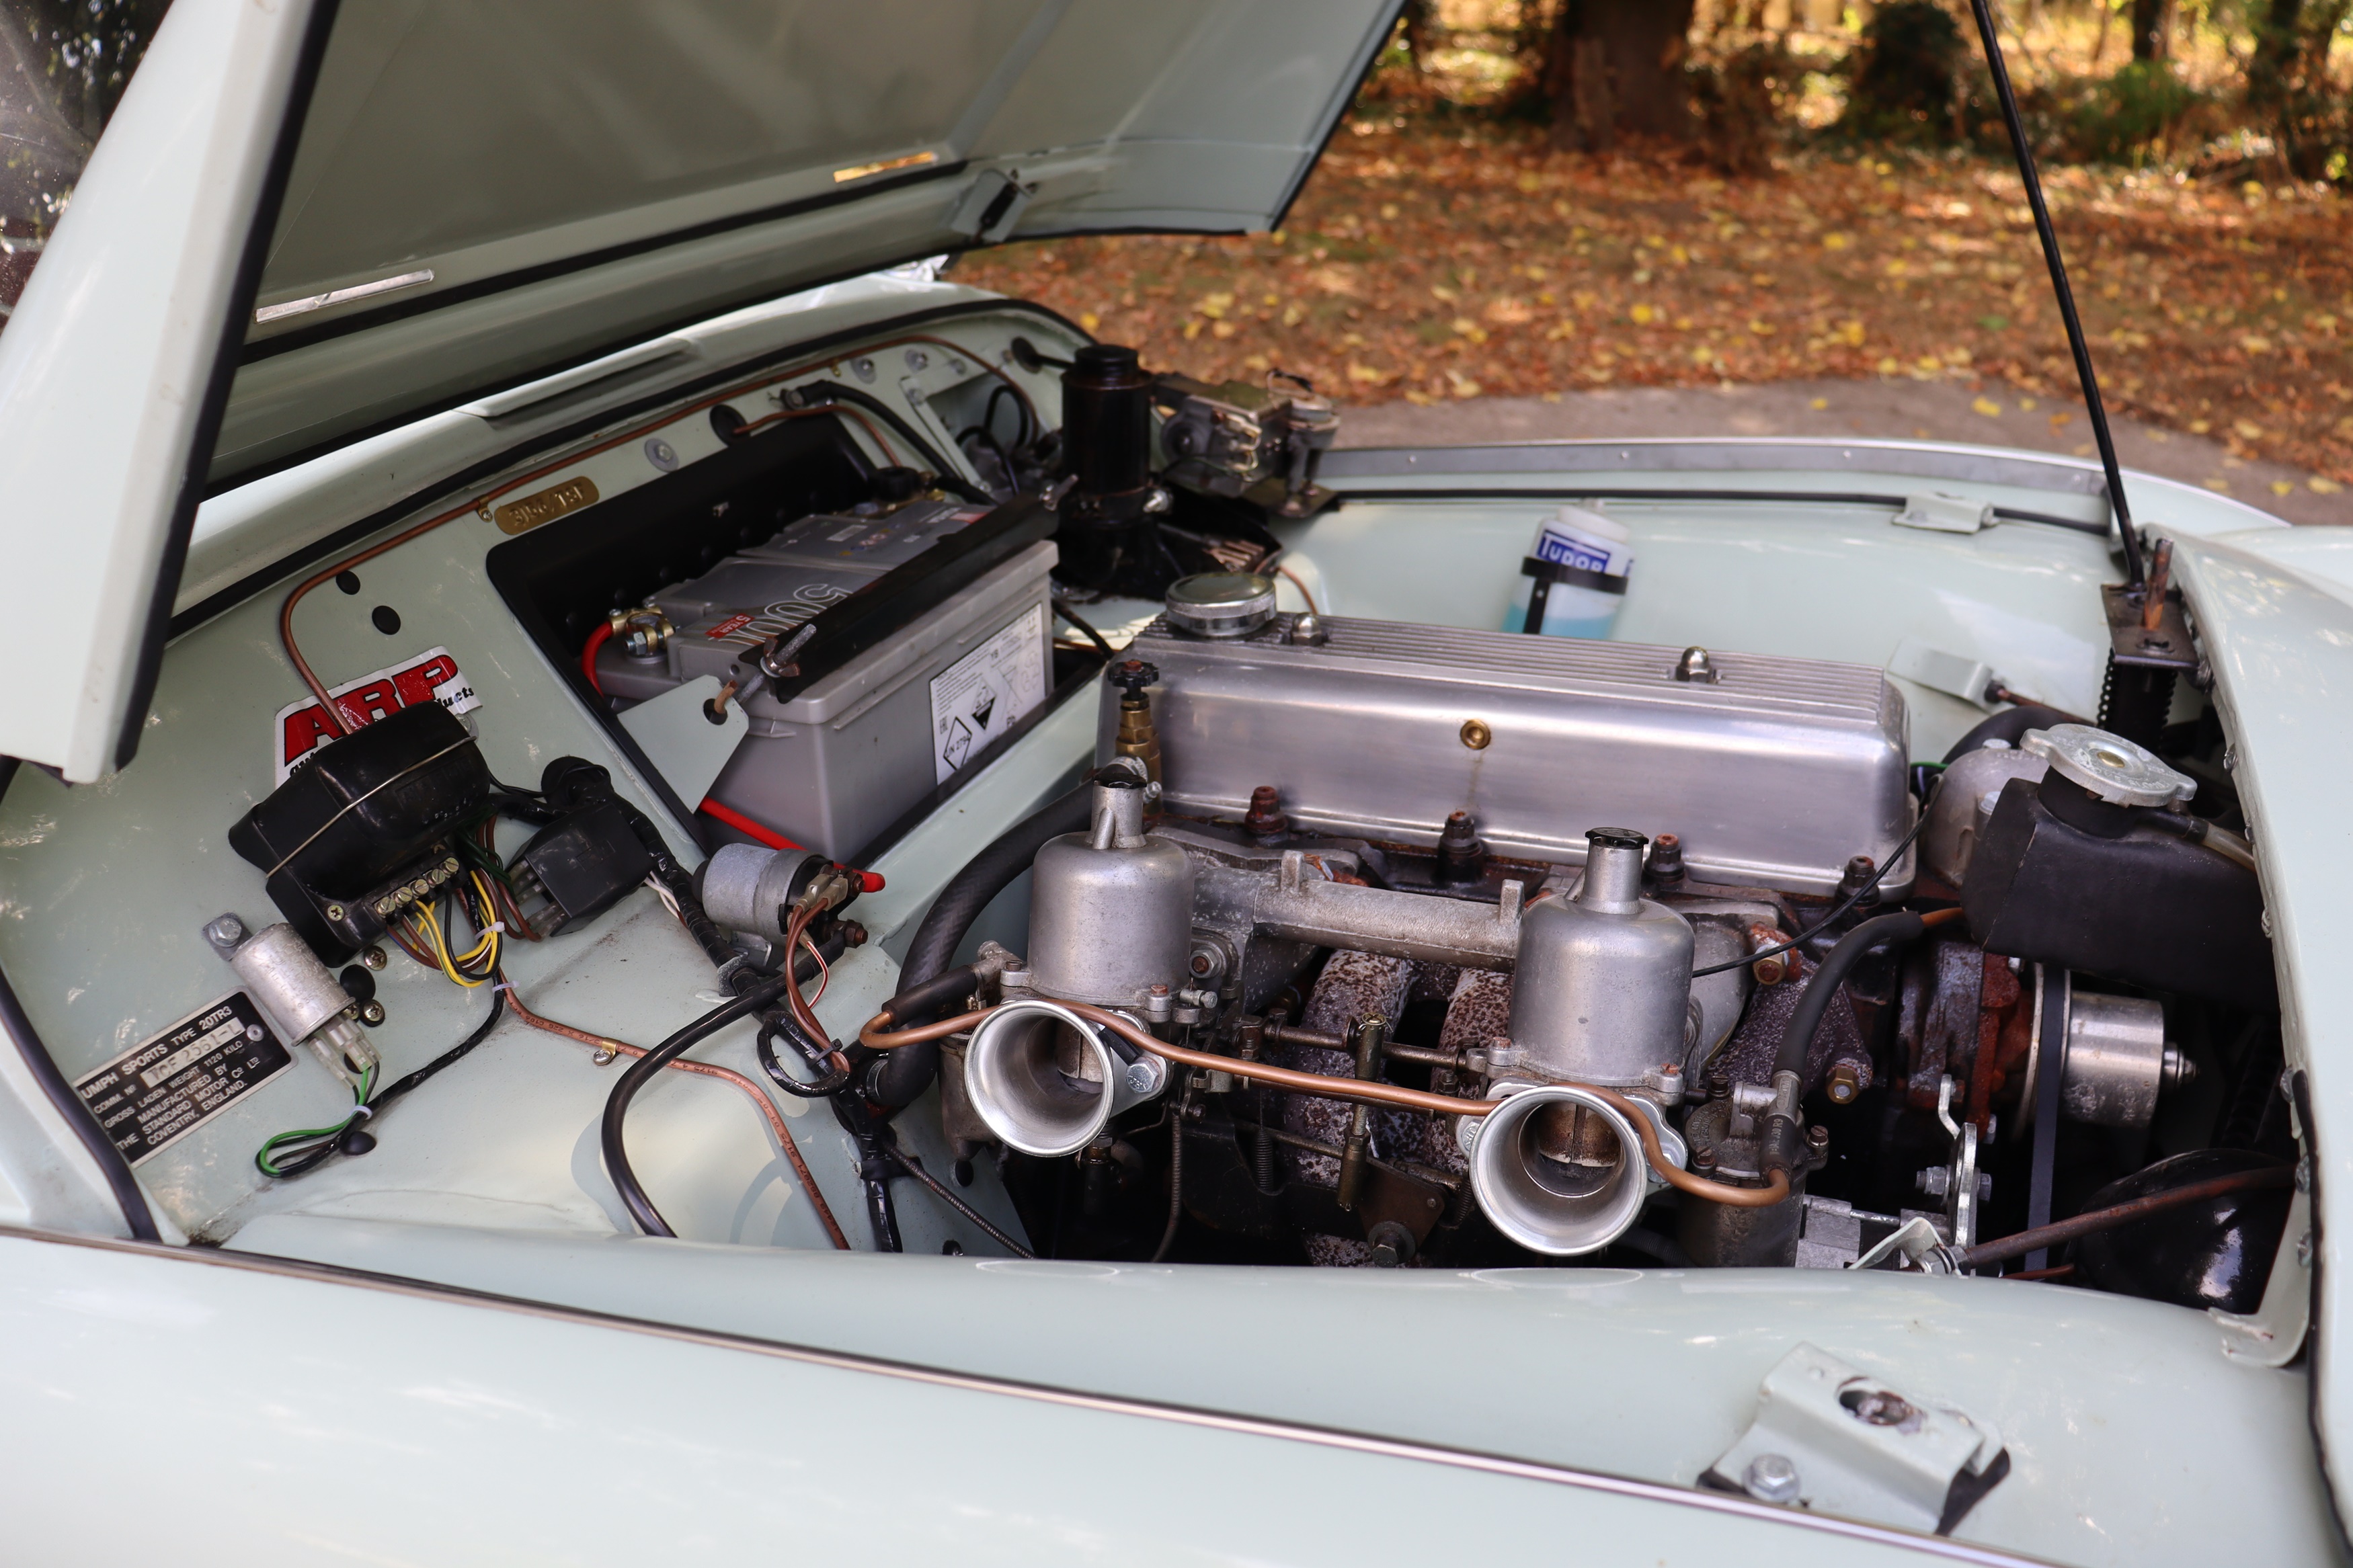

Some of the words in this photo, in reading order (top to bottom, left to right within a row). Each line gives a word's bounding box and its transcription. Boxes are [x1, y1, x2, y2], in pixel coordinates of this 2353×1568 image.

[284, 654, 458, 767] ARP
[81, 1071, 119, 1100] UMPH
[121, 1042, 167, 1075] SPORTS
[171, 1027, 196, 1046] TYPE
[198, 1005, 232, 1030] 20TR3
[93, 1091, 124, 1114] COMM.
[103, 1104, 135, 1129] GROSS
[137, 1085, 167, 1108] LADEN
[168, 1065, 201, 1089] WEIGHT
[203, 1052, 223, 1068] 1120
[116, 1132, 139, 1151] THE
[142, 1099, 192, 1135] STANDARD
[194, 1075, 229, 1102] MOTOR
[136, 1073, 212, 1124] MANUFACTURED
[214, 1063, 229, 1077] BY
[146, 1108, 199, 1146] COVENTRY,
[201, 1077, 248, 1111] ENGLAND.
[1773, 1118, 1784, 1128] R9
